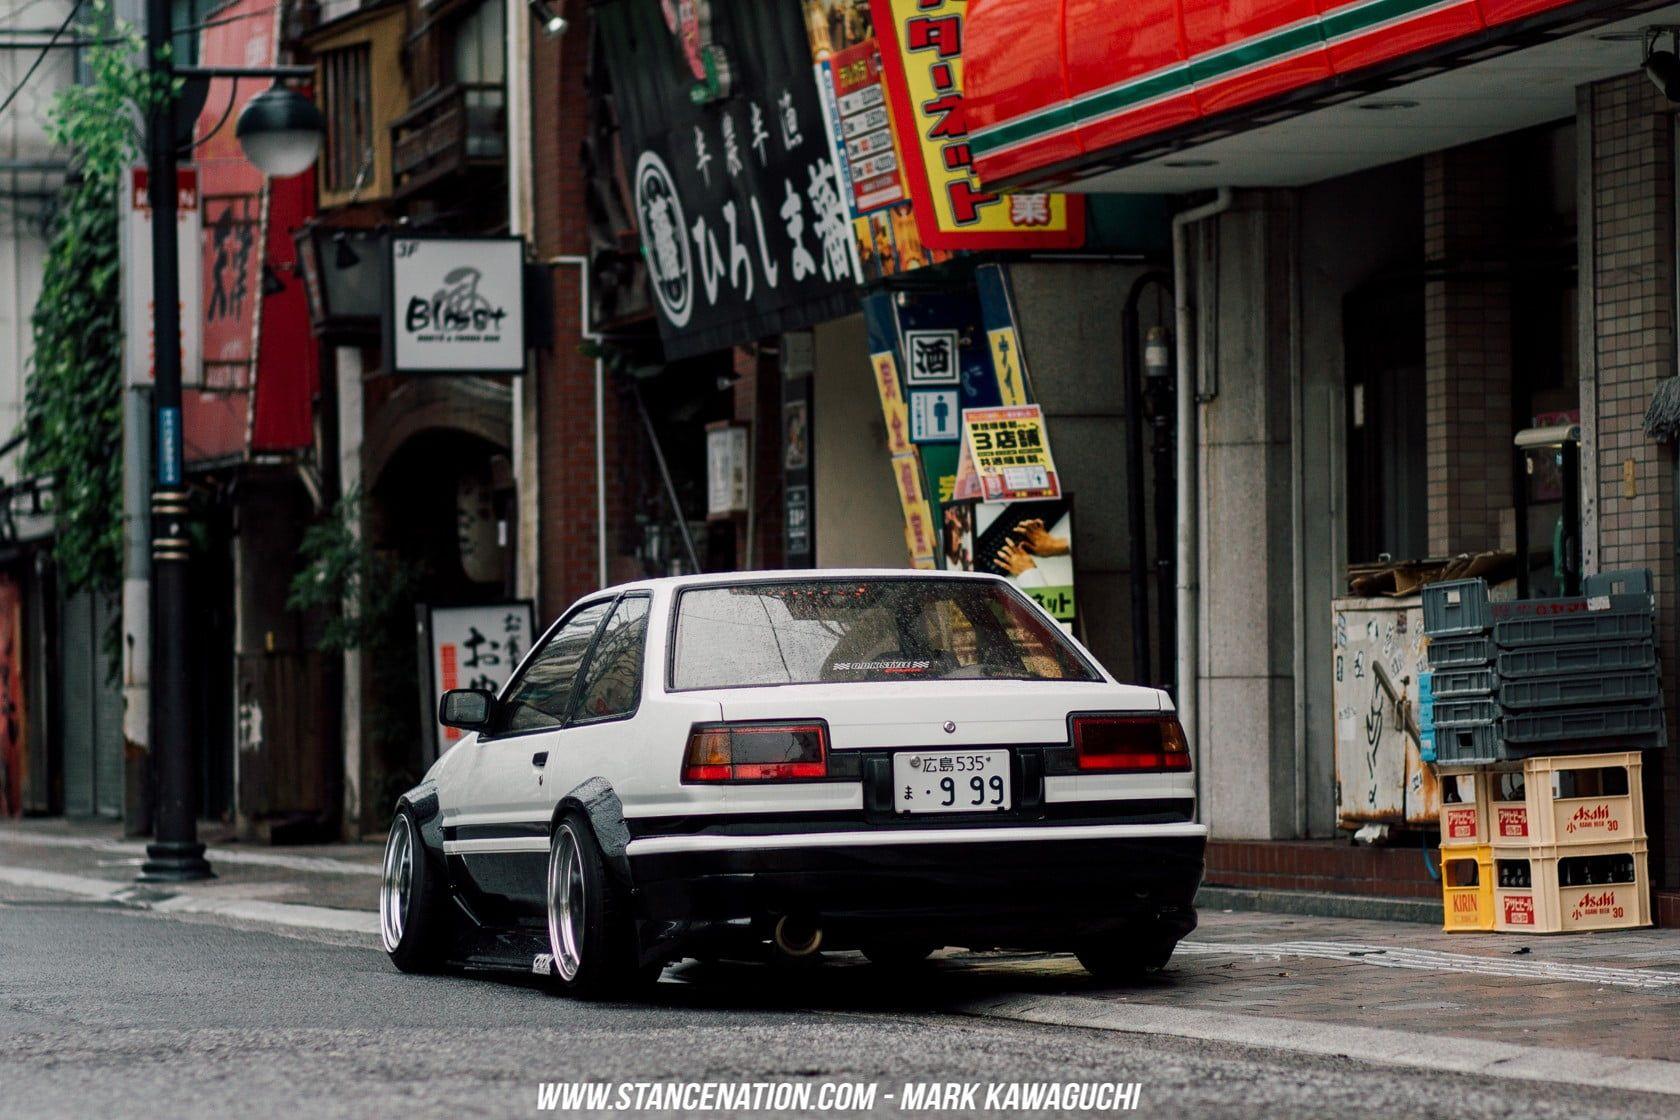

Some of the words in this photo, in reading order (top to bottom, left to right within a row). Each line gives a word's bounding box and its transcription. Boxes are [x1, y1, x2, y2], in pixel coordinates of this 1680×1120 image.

[906, 0, 1003, 225] ターネット
[914, 338, 950, 374] 酒
[973, 428, 1041, 450] 3店舗
[923, 757, 954, 772] 広島
[956, 756, 984, 771] 535
[904, 785, 913, 800] ま
[1448, 810, 1475, 825] アサヒビール
[1499, 809, 1527, 824] アサヒビール
[1573, 804, 1609, 821] Asahi
[1566, 822, 1576, 833] 小
[1607, 820, 1618, 831] 30
[1453, 894, 1478, 912] KIRIN
[1504, 898, 1533, 912] アサヒビール
[1579, 891, 1615, 907] Asahi
[1572, 909, 1582, 920] 小
[1613, 907, 1623, 918] 30
